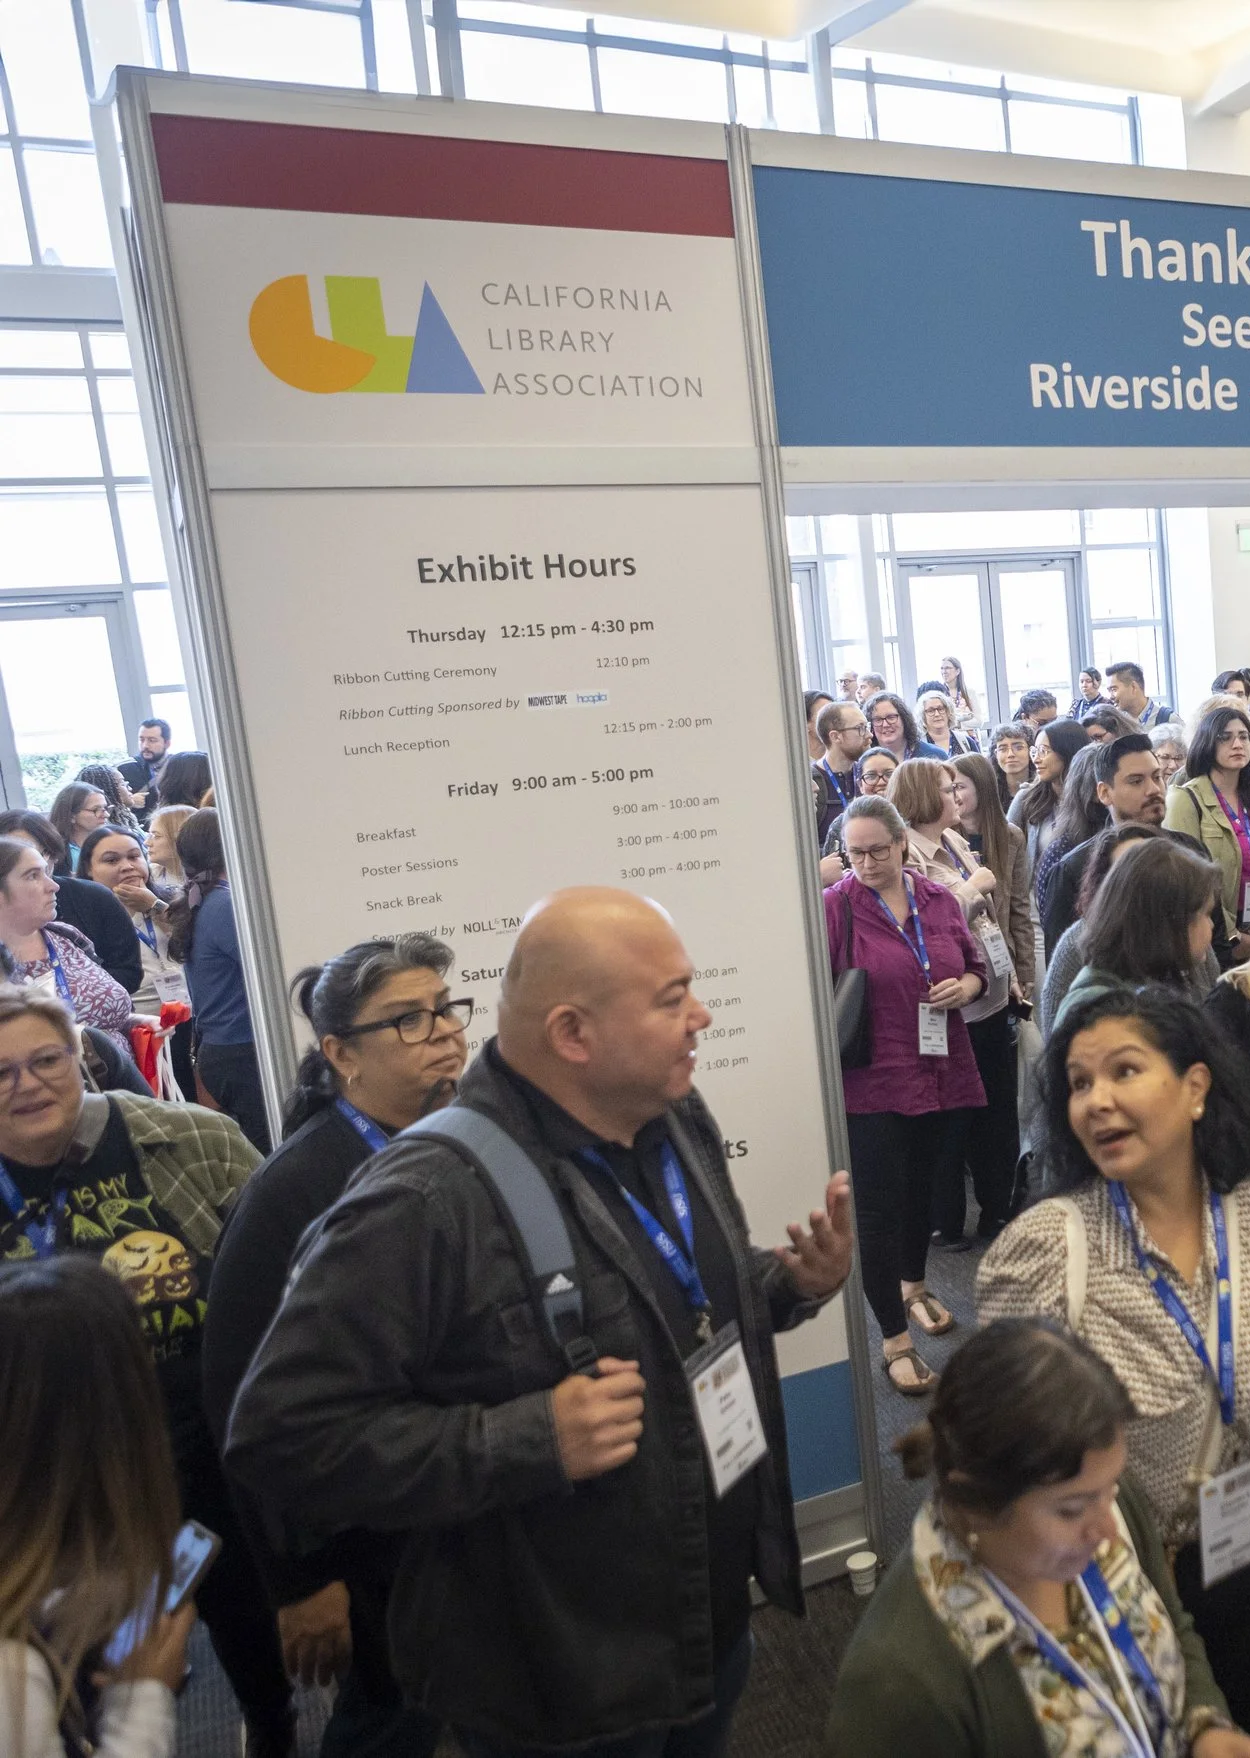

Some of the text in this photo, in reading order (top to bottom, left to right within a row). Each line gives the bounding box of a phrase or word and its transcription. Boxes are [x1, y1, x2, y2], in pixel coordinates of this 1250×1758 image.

[481, 282, 672, 312] CALIFORNIA
[487, 328, 615, 354] LIBRARY
[493, 372, 703, 399] ASSOCIATION
[1029, 362, 1239, 412] Riverside
[417, 553, 637, 584] Exhibit Hours
[407, 626, 486, 645] Thursday
[500, 622, 546, 639] 12:15
[550, 624, 576, 639] pm
[591, 618, 625, 634] 4:30
[629, 619, 655, 634] pm
[596, 656, 650, 669] 12:10 pm
[333, 664, 498, 686] Ribbon Cutting Ceremony
[339, 692, 607, 721] Ribbon Cutting Sponsored by MIDWEST TAPE hoopla
[604, 720, 636, 734] 12:15
[638, 721, 657, 733] pm
[668, 717, 693, 730] 2:00
[696, 717, 713, 729] pm
[343, 737, 451, 756] Lunch Reception
[447, 780, 499, 799] Friday
[512, 775, 548, 792] 9:00
[552, 775, 577, 788] am
[591, 768, 625, 784] 5:00
[630, 767, 655, 784] pm
[613, 803, 638, 815] 9:00
[641, 803, 658, 813] am
[669, 796, 700, 810] 10:00
[702, 796, 720, 806] am
[356, 827, 417, 844] Breakfast
[617, 835, 642, 848] 3:00
[645, 834, 663, 846] pm
[673, 829, 697, 841] 4:00
[700, 827, 718, 839] pm
[361, 857, 459, 878] Poster Sessions
[620, 867, 645, 879] 3:00
[648, 866, 666, 878] pm
[676, 860, 701, 872] 4:00
[703, 858, 721, 871] pm
[366, 892, 443, 912] Snack Break
[441, 924, 456, 937] by
[463, 920, 496, 934] NOLL
[461, 966, 505, 983] Satur
[695, 966, 738, 980] 0:00 am
[724, 996, 741, 1006] am
[703, 1026, 746, 1041] 1:00 pm
[706, 1057, 730, 1071] 1:00
[732, 1056, 749, 1068] pm
[72, 1173, 129, 1210] IS MY
